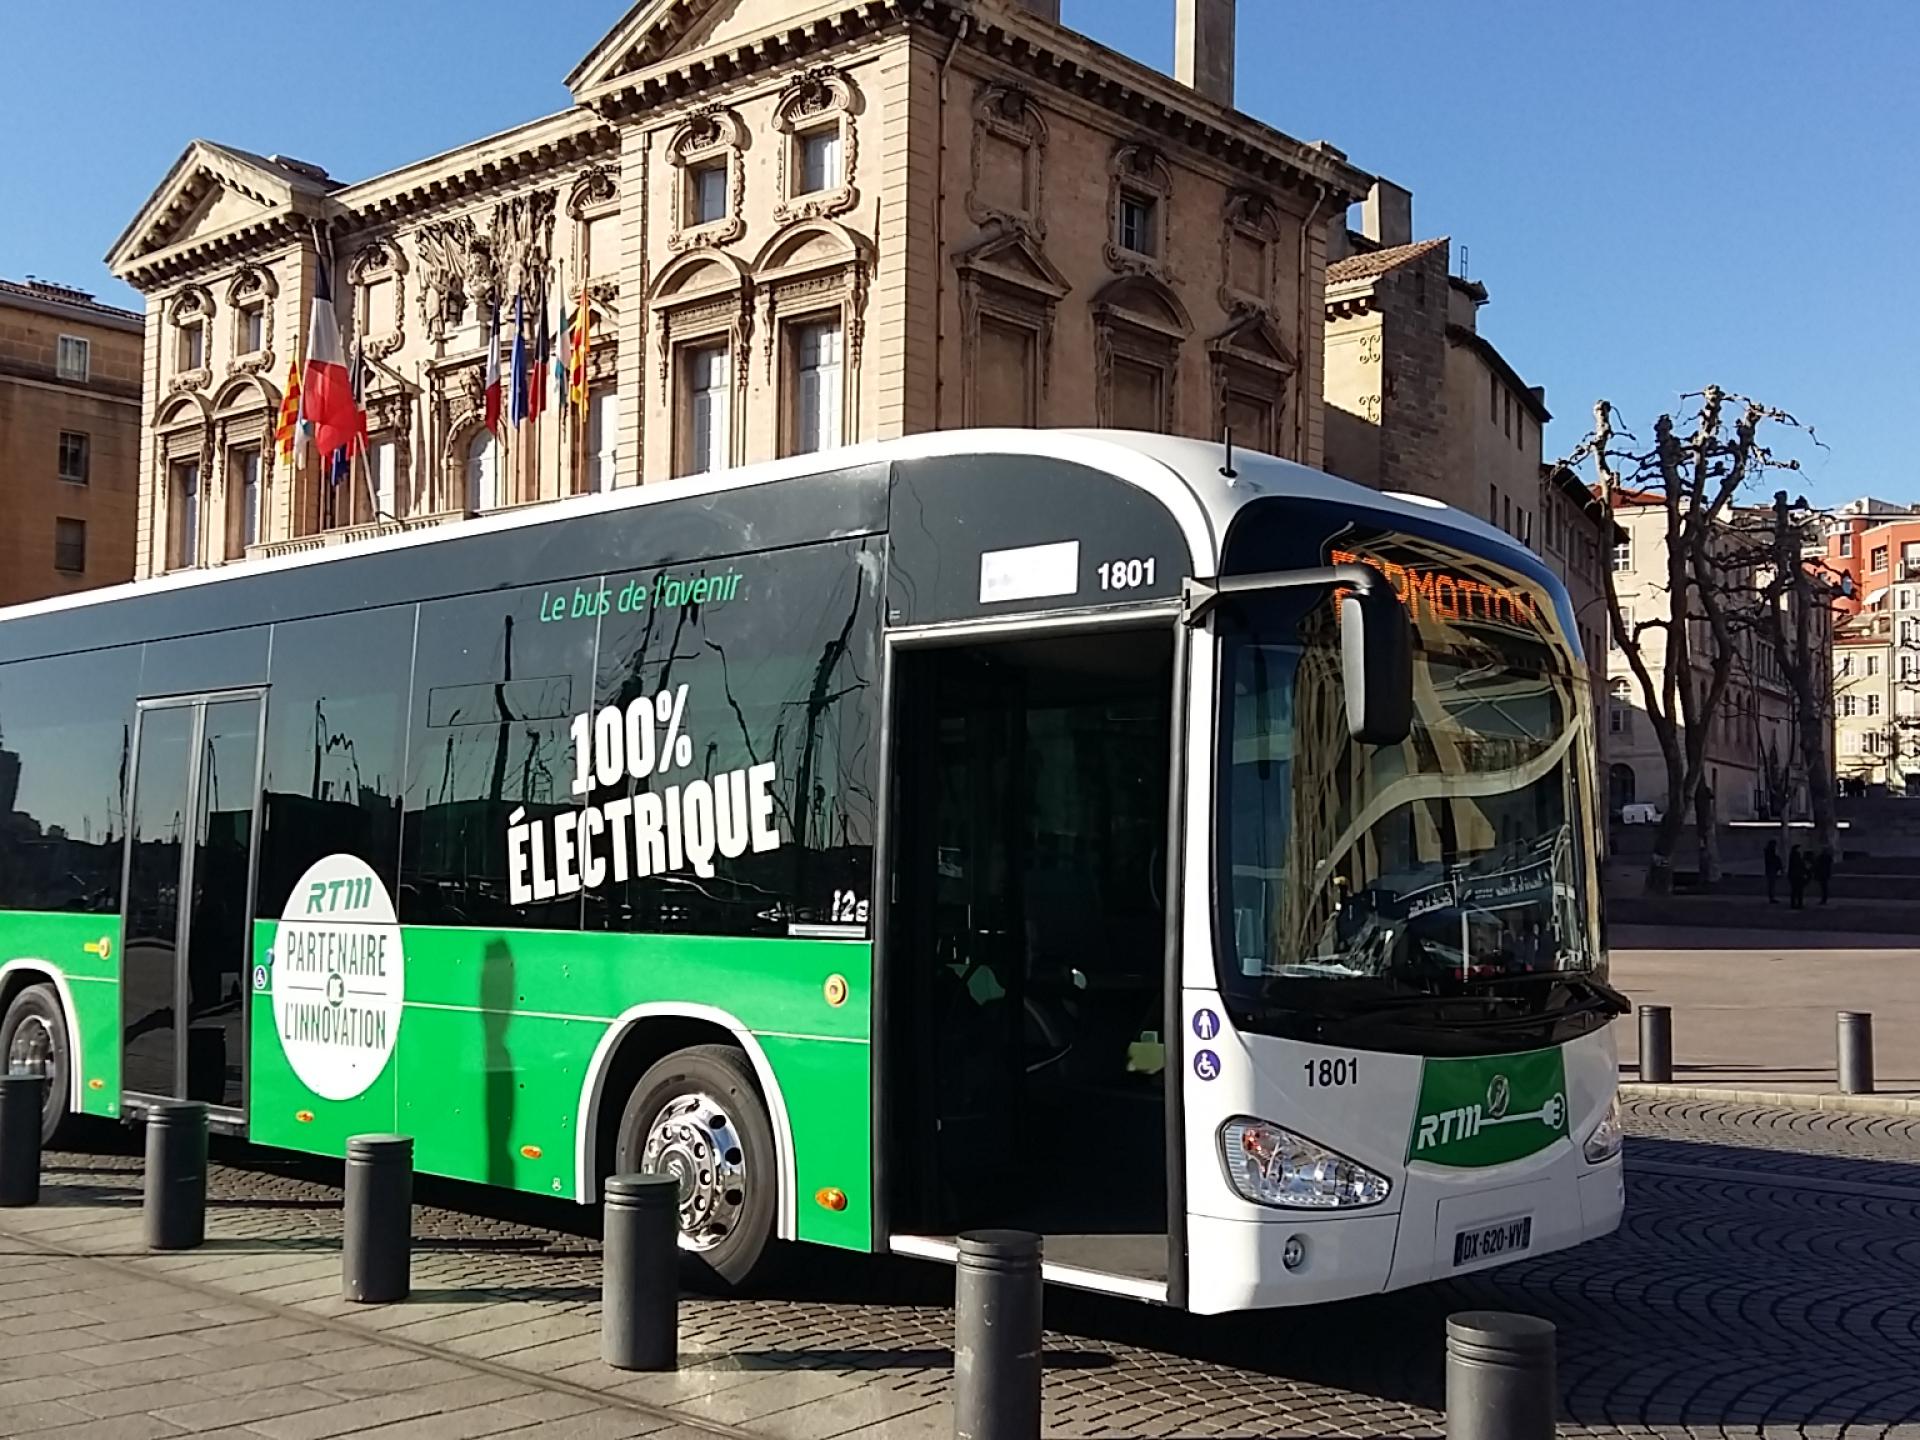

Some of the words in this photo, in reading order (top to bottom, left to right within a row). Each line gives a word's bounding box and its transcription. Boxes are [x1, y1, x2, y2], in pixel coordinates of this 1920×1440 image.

[540, 592, 566, 622] Le
[571, 586, 612, 618] bus
[617, 580, 647, 613] de
[653, 566, 743, 609] l'avenir
[1097, 557, 1155, 590] 1801
[570, 684, 692, 795] 100%
[507, 761, 781, 906] ÉLECTRIQUE
[306, 876, 372, 914] RTM
[286, 930, 388, 977] PARTENAIRE
[284, 1001, 387, 1050] L'INNOVATION
[1304, 1057, 1358, 1088] 1801
[1417, 1104, 1482, 1150] RTM
